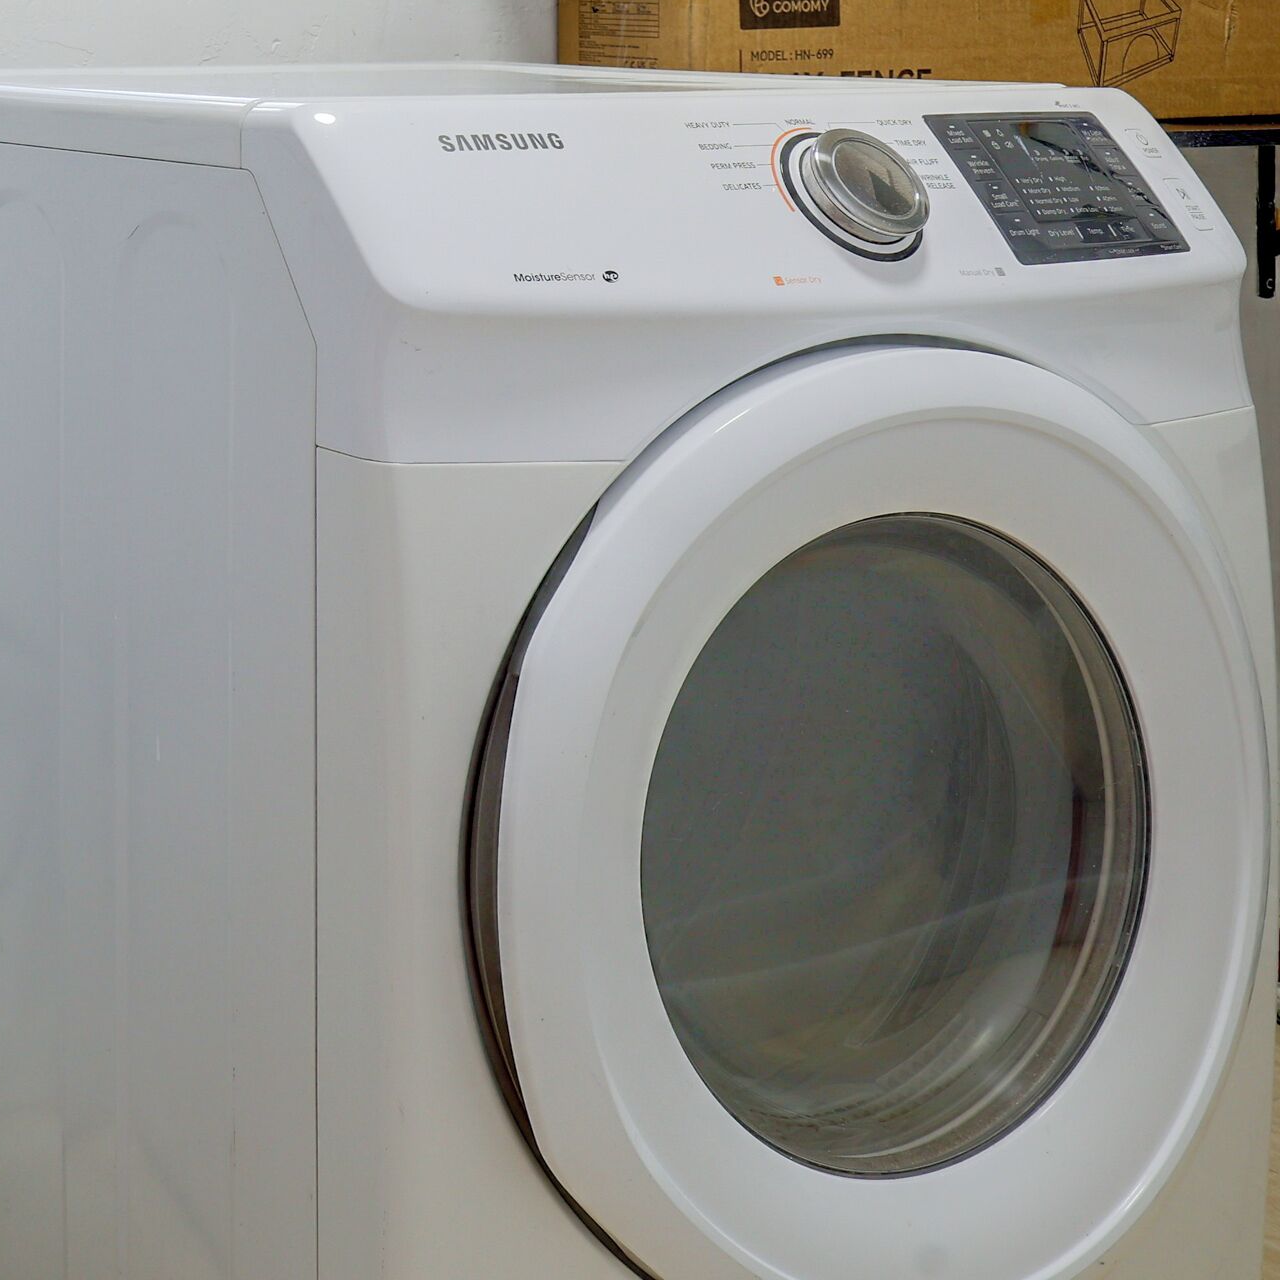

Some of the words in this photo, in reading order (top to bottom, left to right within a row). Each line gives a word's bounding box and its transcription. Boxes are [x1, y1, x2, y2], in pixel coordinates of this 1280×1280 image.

[794, 49, 835, 60] HN-699
[438, 133, 565, 152] SAMSUNG
[722, 183, 762, 191] DELICATES
[513, 272, 596, 282] MoistureSensor
